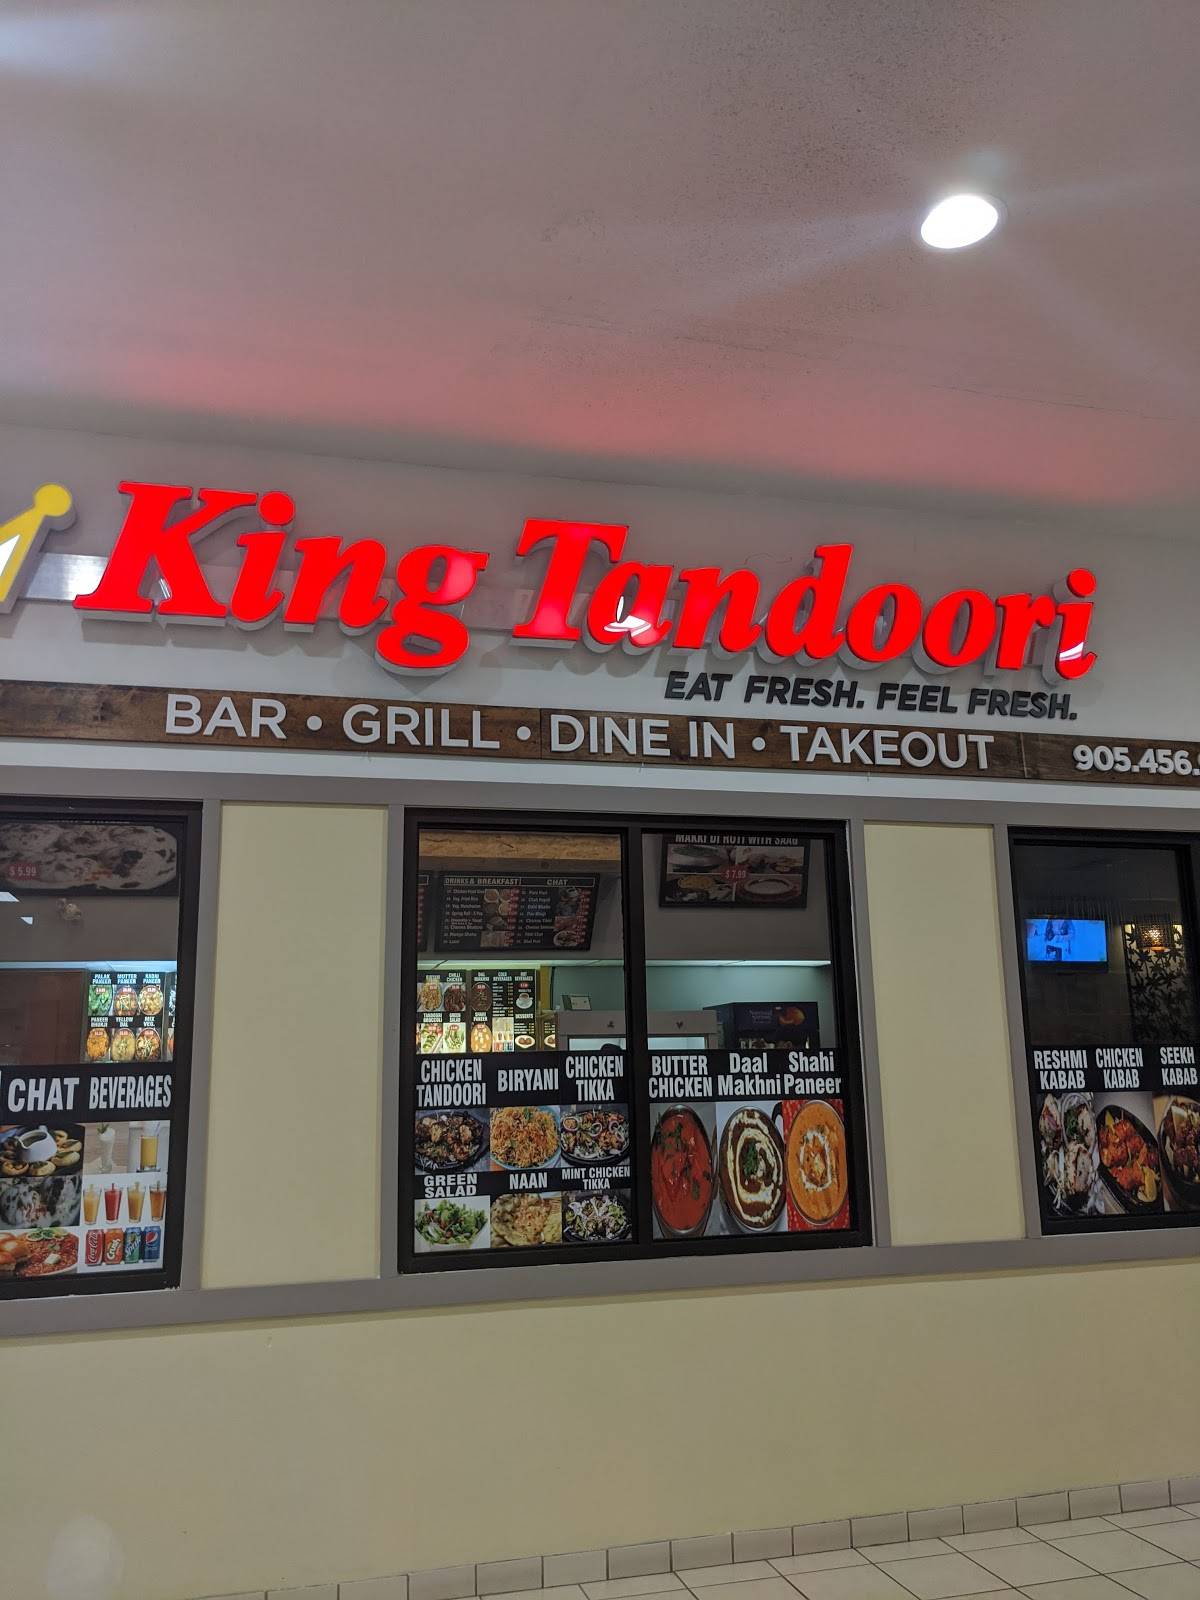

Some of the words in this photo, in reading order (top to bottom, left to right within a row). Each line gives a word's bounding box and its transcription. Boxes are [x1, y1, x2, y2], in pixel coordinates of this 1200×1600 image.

[73, 480, 489, 669] King
[512, 519, 1097, 680] Tandoori
[664, 671, 733, 701] EAT
[744, 674, 866, 709] FRESH.
[877, 682, 958, 715] FEEL
[967, 688, 1078, 720] FRESH.
[165, 694, 287, 739] BAR
[342, 704, 500, 751] GRILL
[550, 714, 670, 757] DINE
[688, 720, 735, 759] IN
[780, 725, 994, 769] TAKEOUT
[1073, 744, 1200, 776] 905.456.
[477, 878, 519, 886] BREAKFAST
[651, 1055, 708, 1076] BUTTER
[729, 1052, 768, 1074] Daal
[788, 1051, 835, 1073] Shahi
[1033, 1049, 1088, 1070] RESHMI
[1095, 1047, 1144, 1068] CHICKEN
[1159, 1046, 1195, 1065] SEEKH
[420, 1058, 482, 1083] CHICKEN
[565, 1055, 624, 1079] CHICKEN
[1161, 1067, 1198, 1086] KABAB
[497, 1068, 559, 1092] BIRYANI
[648, 1076, 713, 1098] CHICKEN
[718, 1074, 782, 1096] Makhni
[784, 1074, 842, 1096] Paneer
[1039, 1069, 1086, 1090] KABAB
[1103, 1068, 1140, 1089] KABAB
[8, 1077, 80, 1112] CHAT
[88, 1075, 172, 1110] BEVERAGES
[416, 1082, 487, 1107] TANDOORI
[576, 1079, 615, 1102] TIKKA
[423, 1173, 478, 1187] GREEN
[509, 1172, 548, 1190] NAAN
[562, 1168, 588, 1180] MINT
[589, 1166, 631, 1179] CHICKEN
[582, 1178, 611, 1190] TIKKA
[424, 1184, 477, 1199] SALAD
[107, 1238, 121, 1260] Crush
